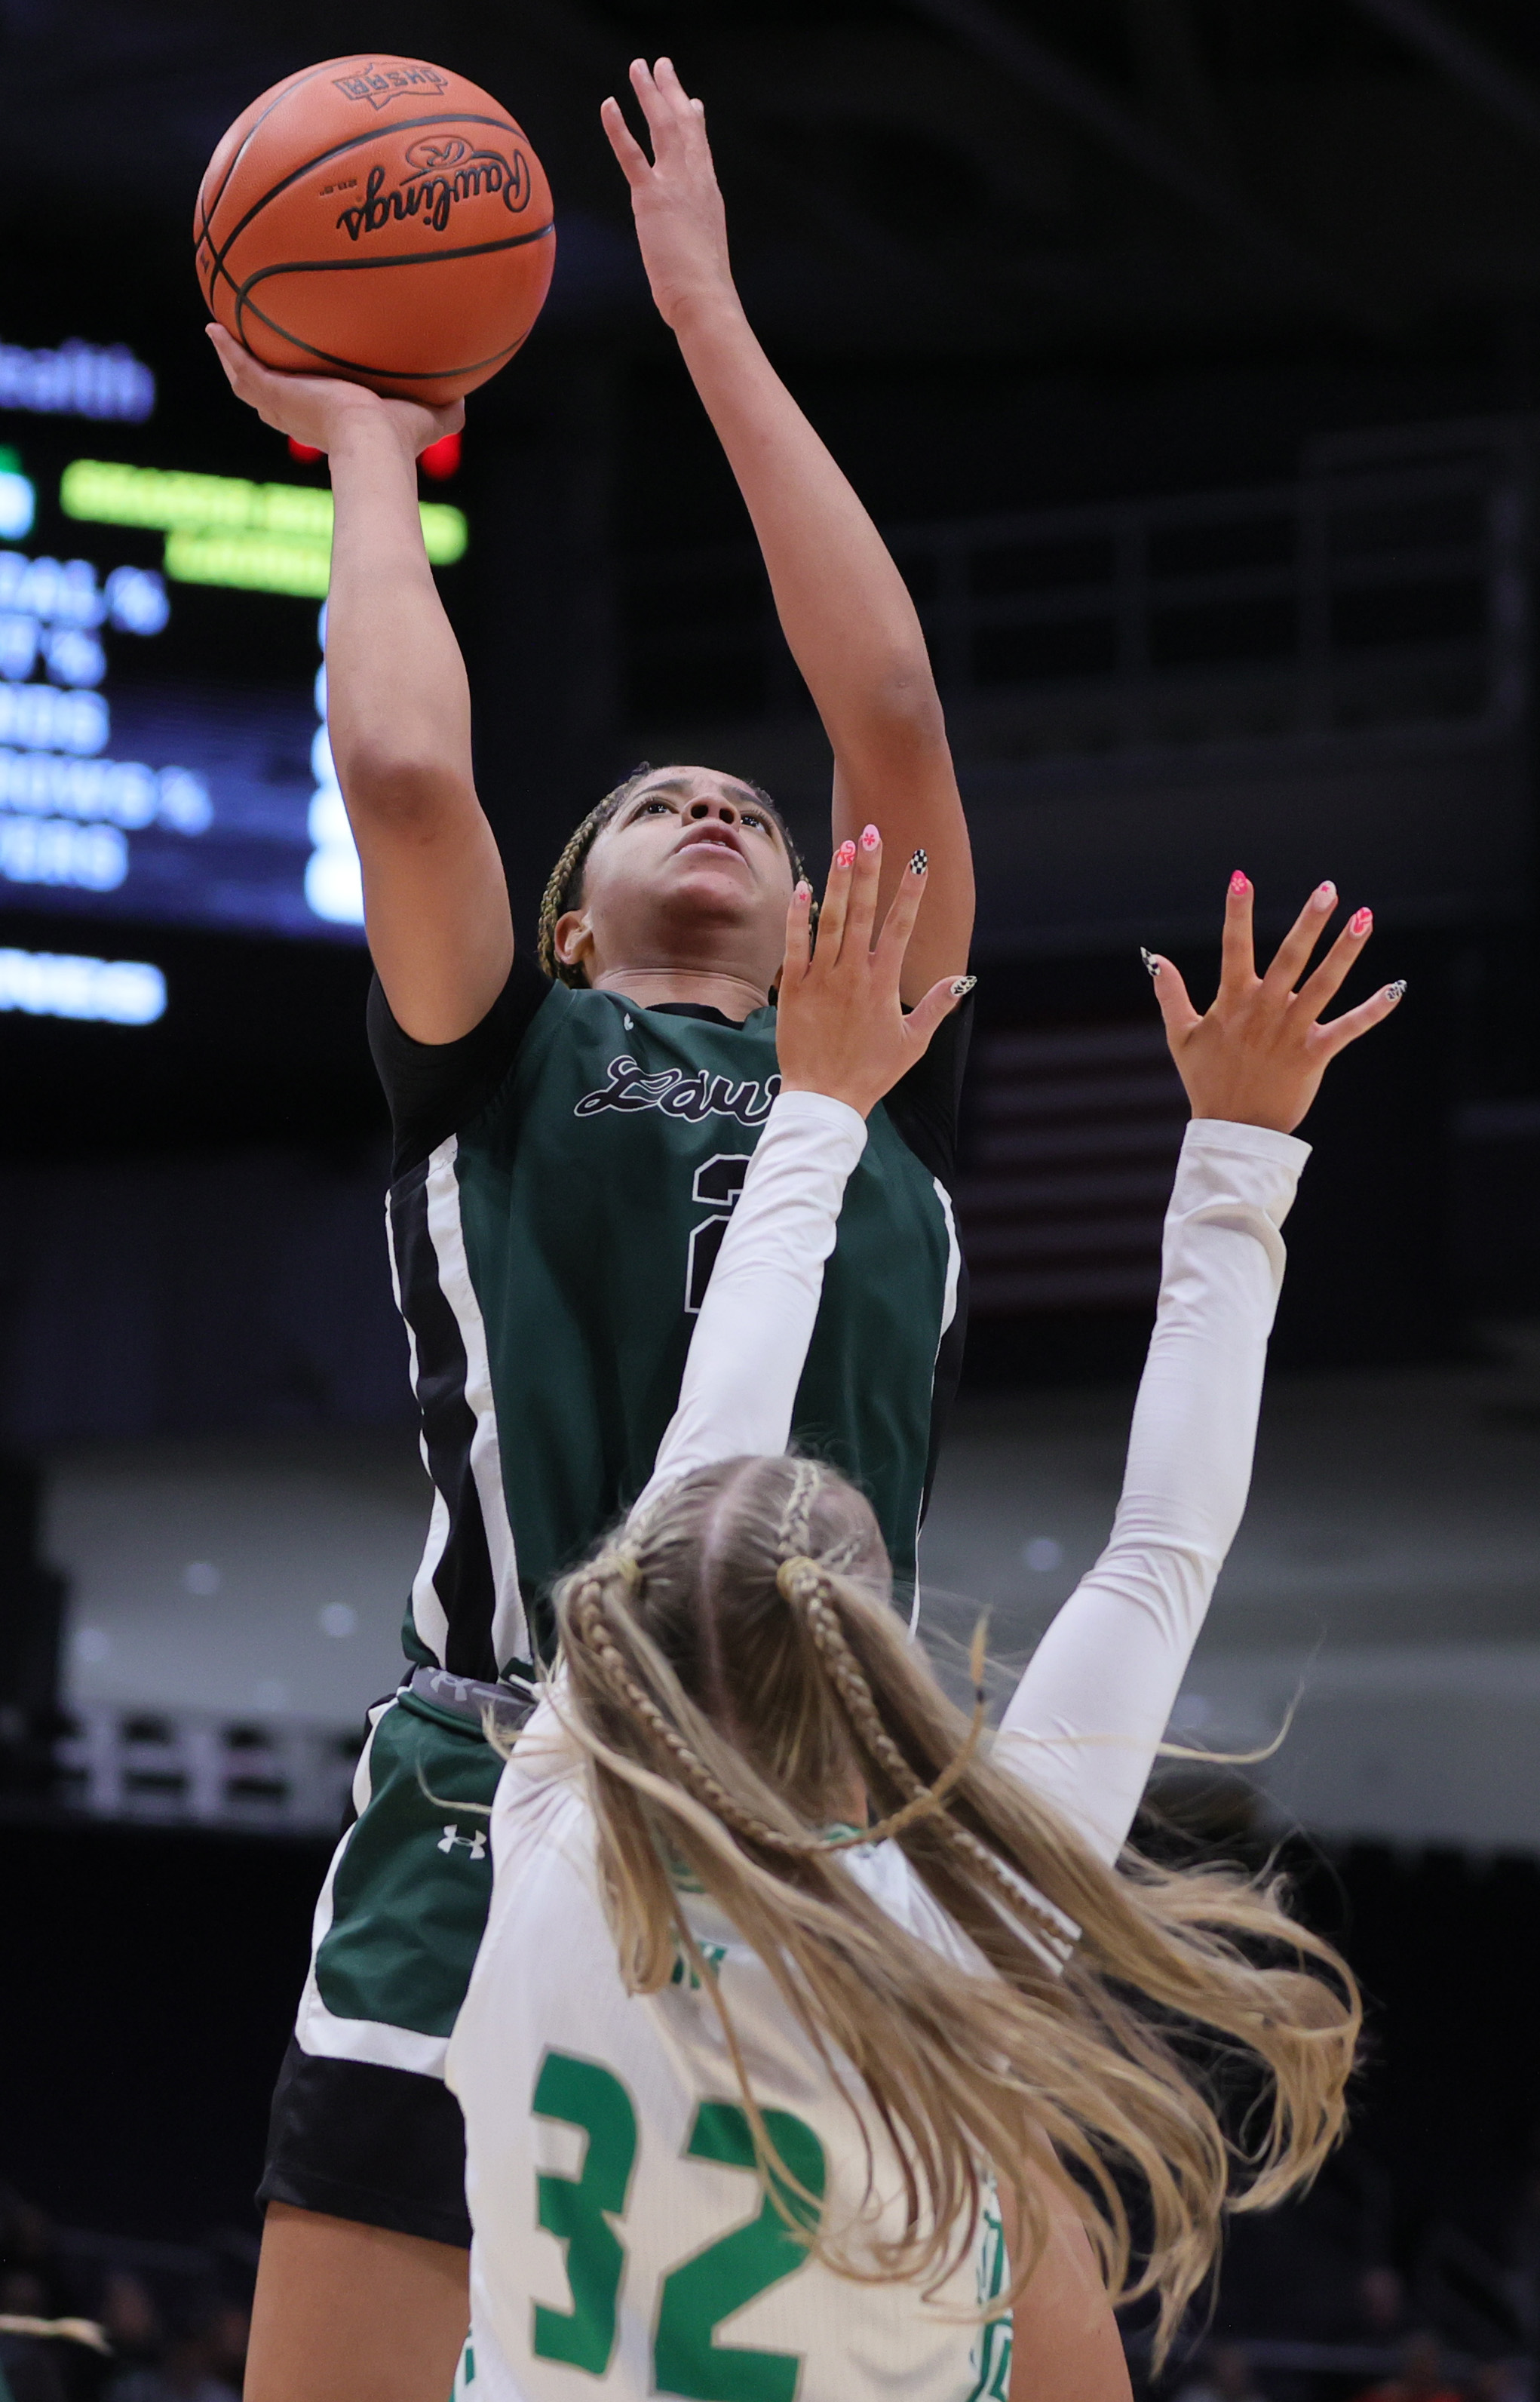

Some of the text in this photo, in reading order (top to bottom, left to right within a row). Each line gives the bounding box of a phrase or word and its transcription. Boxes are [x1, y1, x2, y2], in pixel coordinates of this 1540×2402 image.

[343, 69, 443, 95] OHSAA
[336, 149, 531, 241] Rawlings
[530, 2043, 828, 2402] 32
